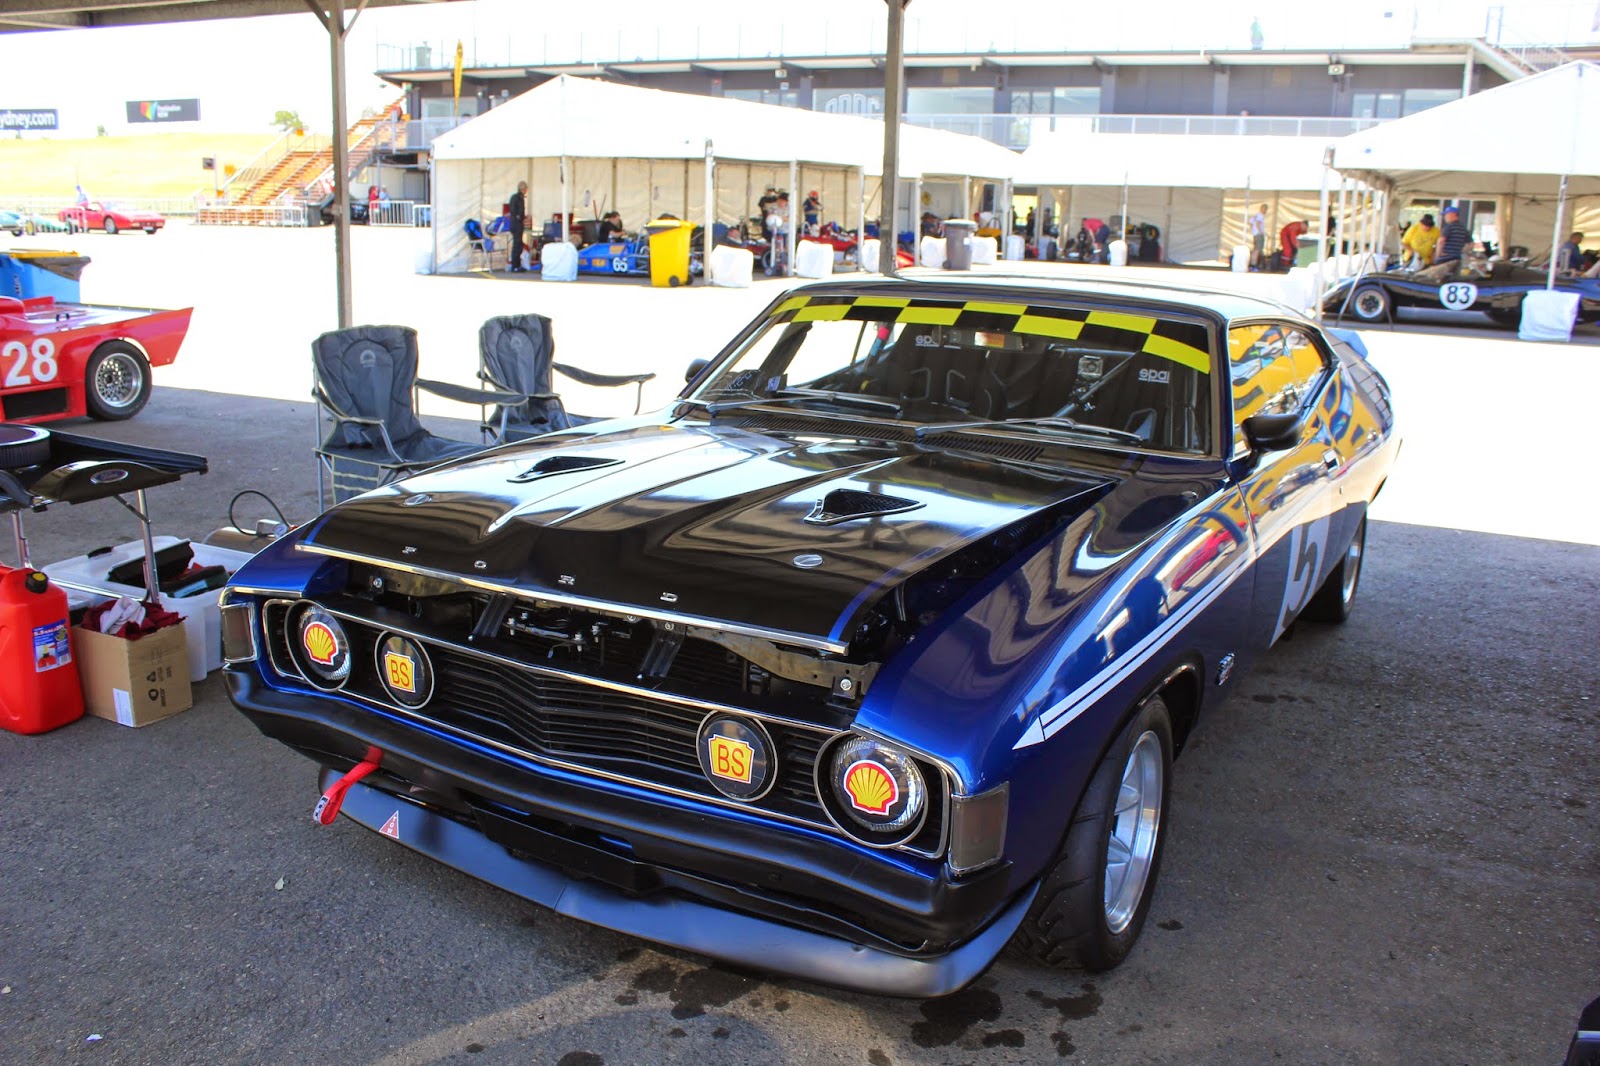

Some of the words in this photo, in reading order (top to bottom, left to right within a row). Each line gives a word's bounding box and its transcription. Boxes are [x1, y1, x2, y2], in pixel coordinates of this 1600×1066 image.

[613, 257, 628, 272] 65
[1447, 285, 1470, 304] 83
[2, 338, 58, 387] 28
[390, 659, 410, 687] BS
[718, 744, 745, 777] BS
[386, 816, 397, 834] TOW
